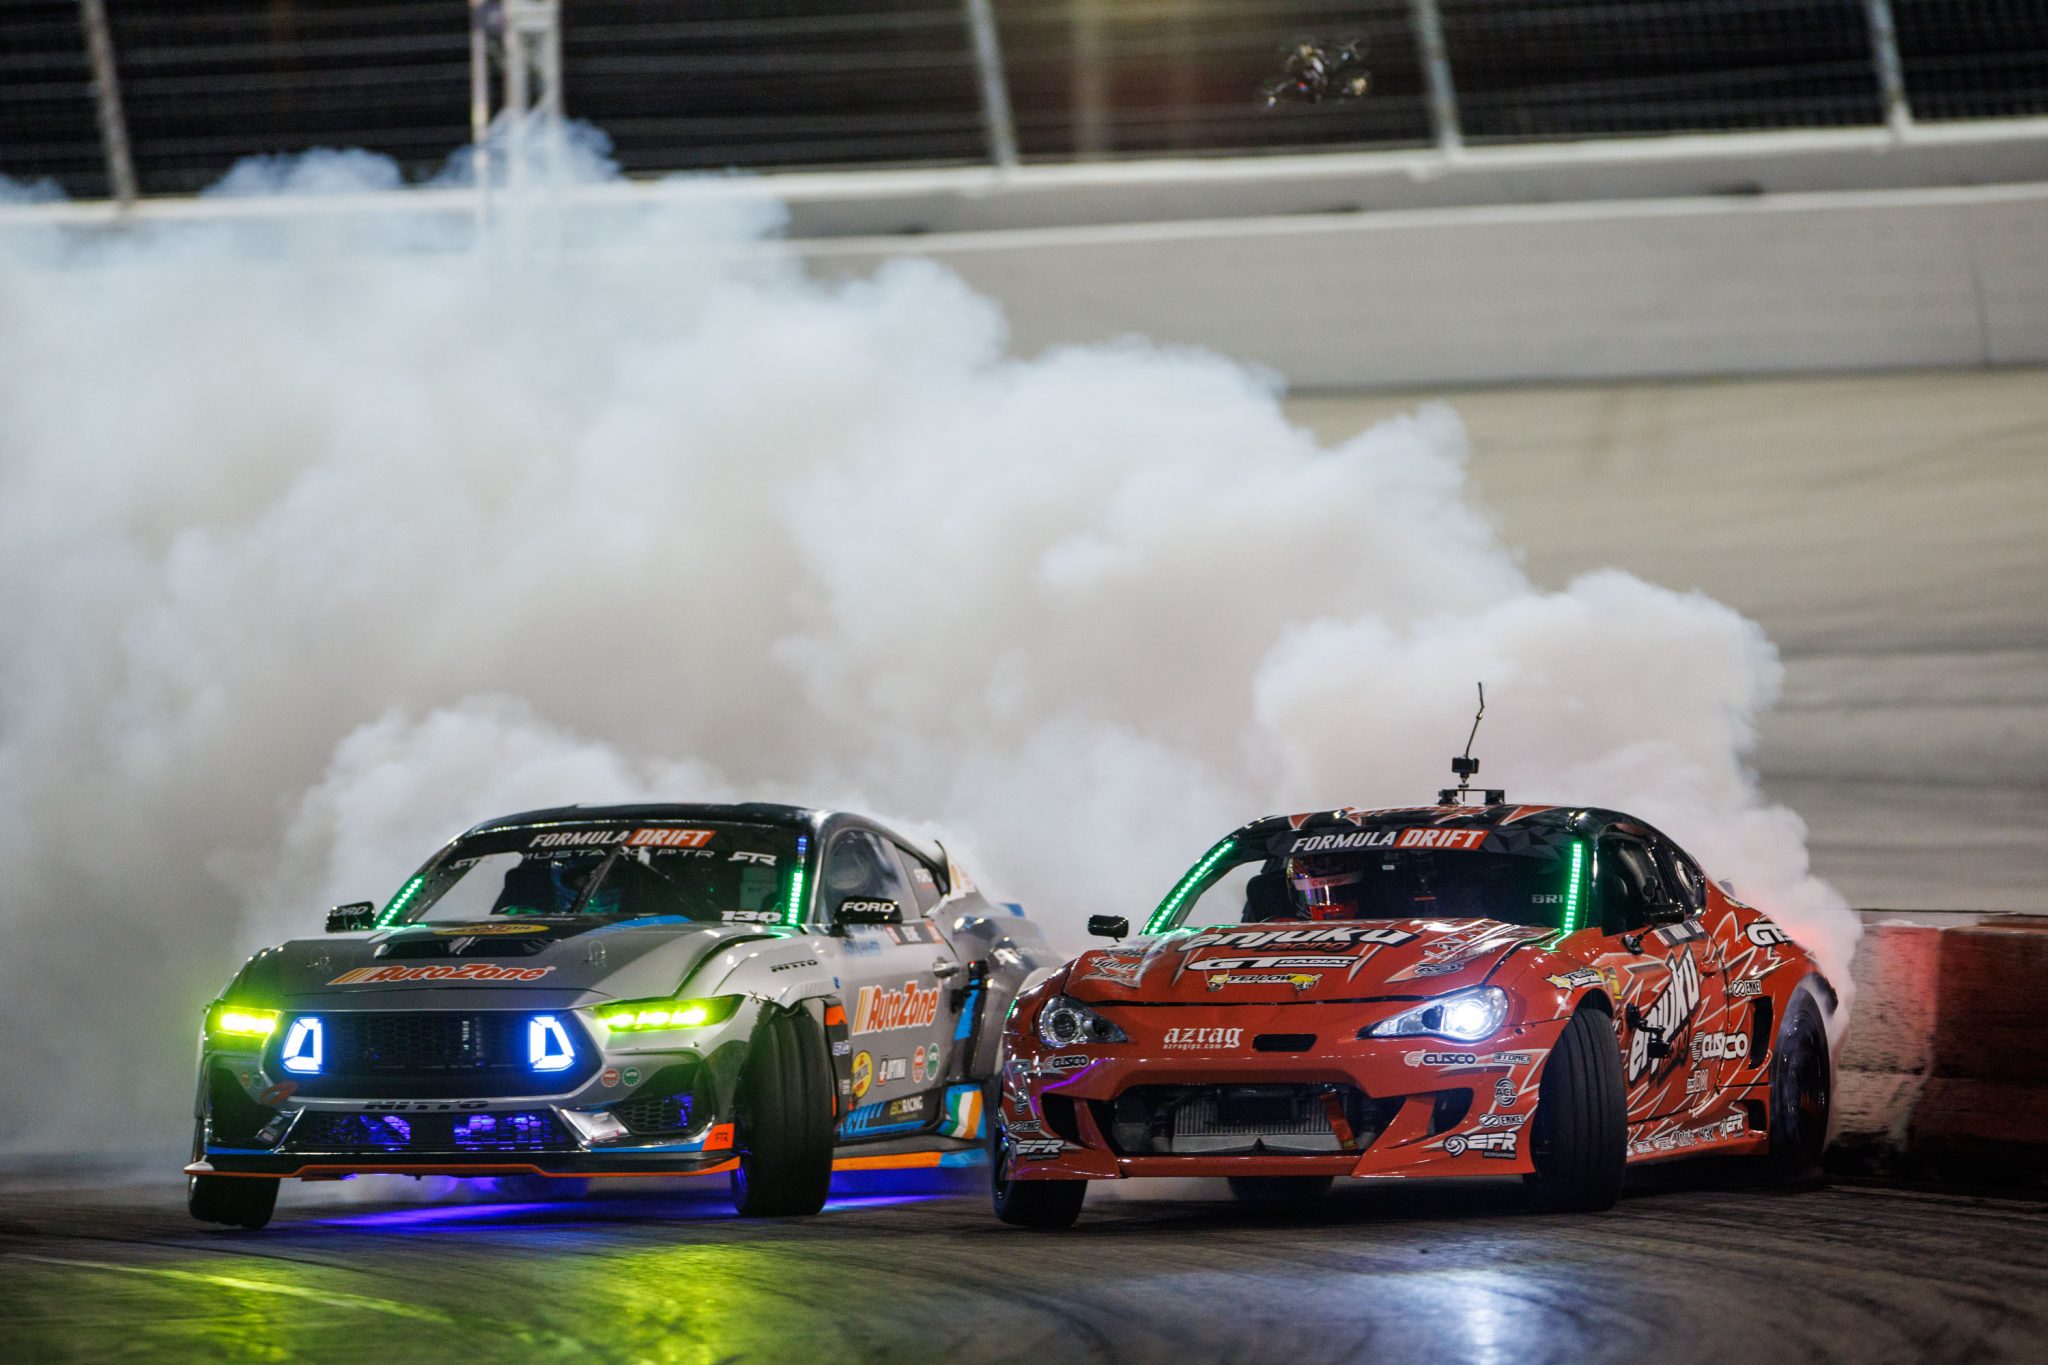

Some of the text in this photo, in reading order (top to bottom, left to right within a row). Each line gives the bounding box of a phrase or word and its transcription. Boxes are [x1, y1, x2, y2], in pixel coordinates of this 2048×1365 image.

[529, 829, 708, 848] FORMULA DRIFT
[1290, 830, 1484, 852] FORMULA DRIFT
[841, 902, 896, 913] FORD
[721, 910, 782, 924] 130
[1180, 927, 1413, 951] enjuku
[770, 959, 819, 973] NITTO
[1188, 956, 1351, 970] GT RADIAL
[366, 965, 548, 981] AutoZone
[866, 980, 939, 1032] AutoZone
[1163, 1027, 1245, 1049] azrag
[1702, 1031, 1749, 1059] CUSCO
[1052, 1055, 1088, 1068] CUSCO
[1423, 1053, 1477, 1065] CUSCO
[1496, 1087, 1517, 1098] ACL
[1501, 1114, 1525, 1125] ENKEI
[1016, 1139, 1064, 1155] EFR
[1467, 1132, 1517, 1151] EFR
